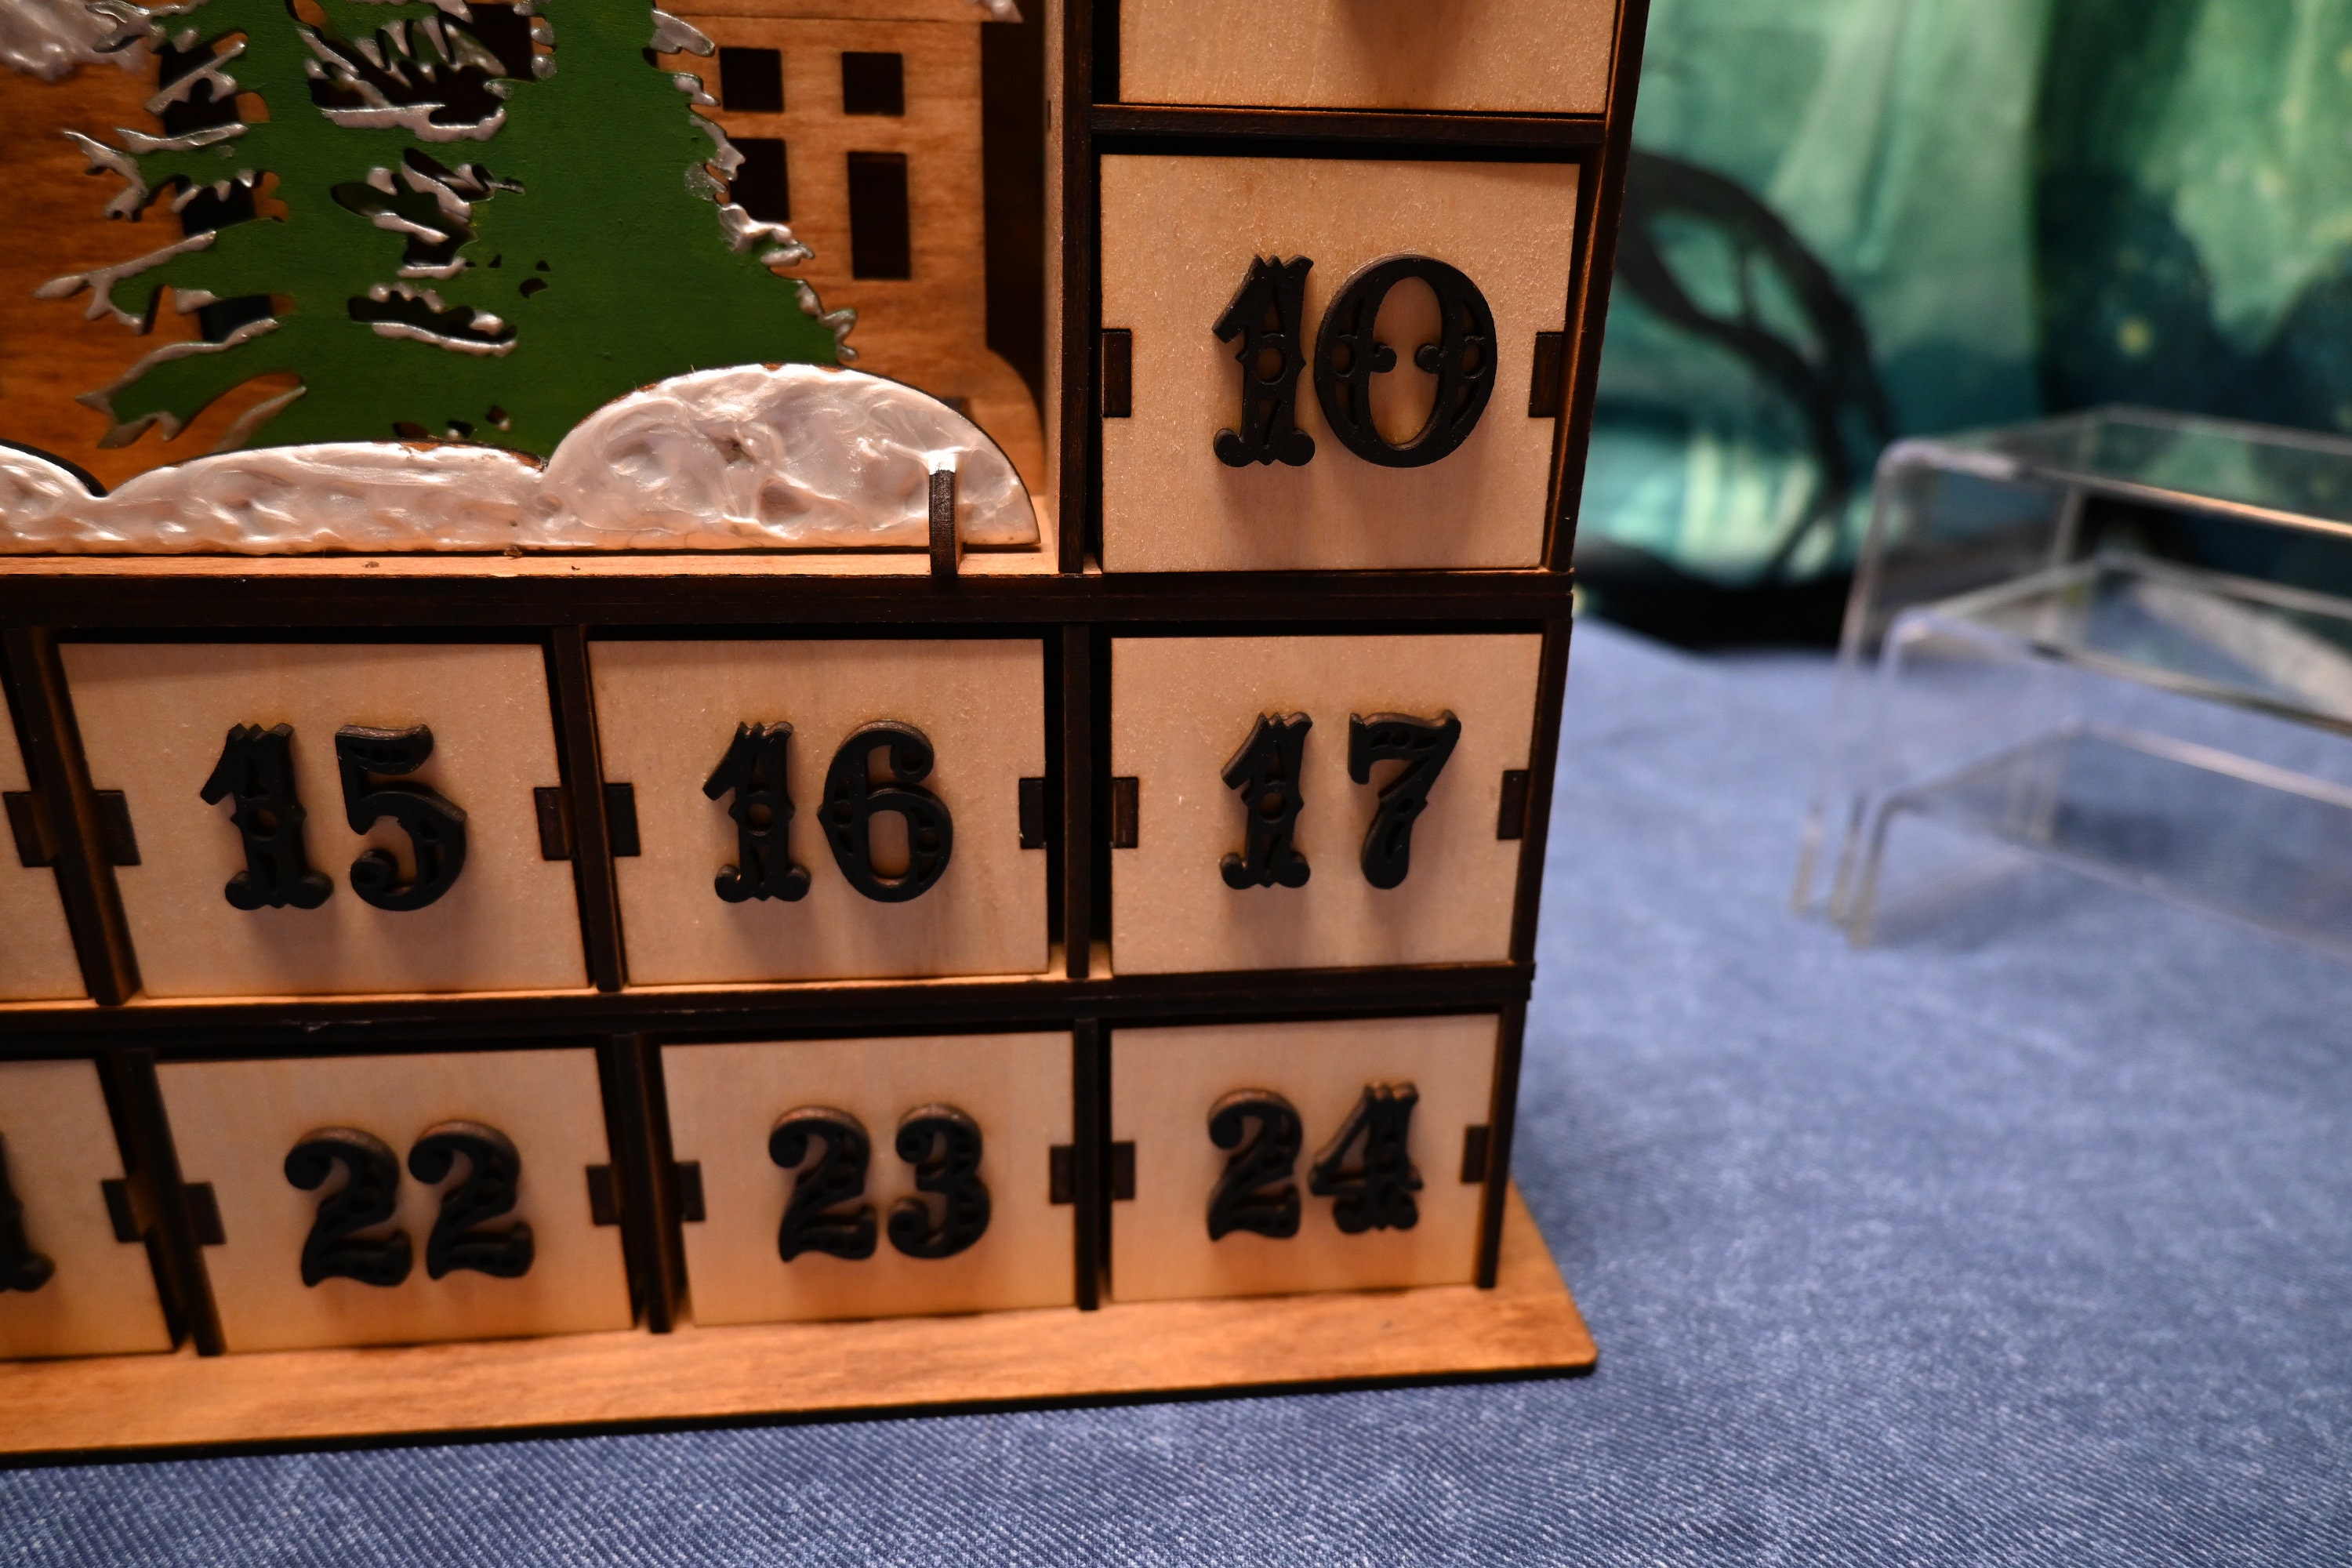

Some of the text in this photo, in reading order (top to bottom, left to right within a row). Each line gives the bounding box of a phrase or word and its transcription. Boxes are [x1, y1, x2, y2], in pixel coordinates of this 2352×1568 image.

[1212, 253, 1498, 468] 10
[200, 721, 468, 911] 15
[702, 719, 953, 903] 16
[1220, 709, 1462, 890] 17
[284, 1120, 535, 1288] 22
[768, 1103, 992, 1264] 23
[1207, 1081, 1424, 1242] 24
